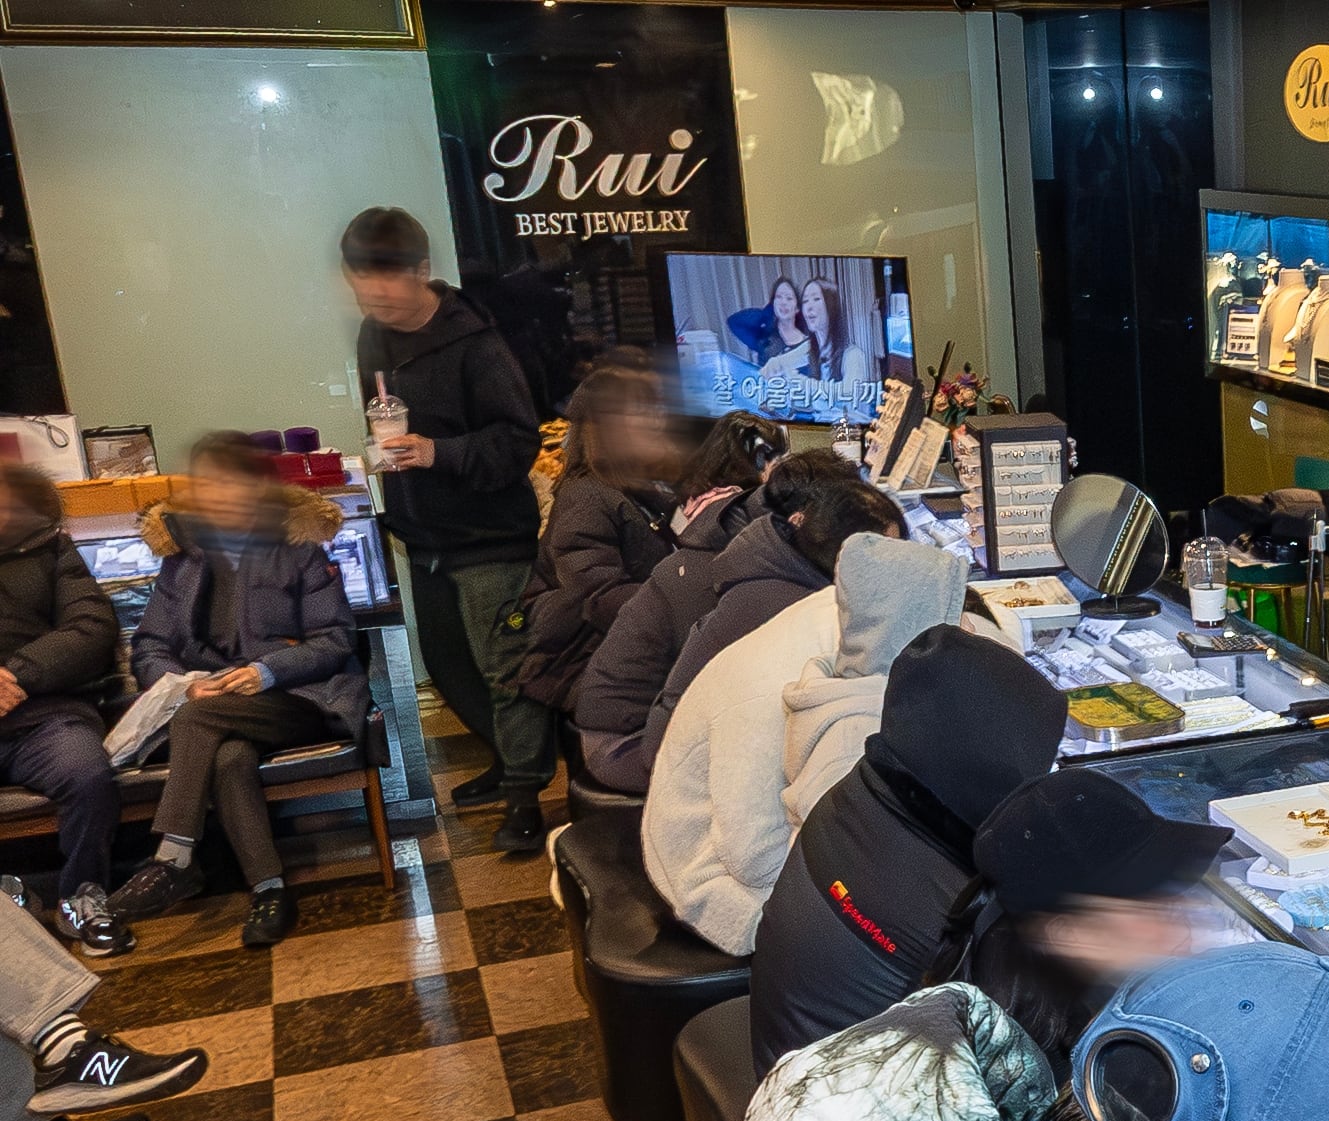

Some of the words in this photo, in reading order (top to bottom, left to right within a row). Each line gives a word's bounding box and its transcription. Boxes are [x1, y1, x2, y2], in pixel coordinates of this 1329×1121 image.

[483, 113, 707, 202] Rui
[516, 213, 577, 236] BEST
[581, 210, 690, 241] JEWELRY
[713, 374, 736, 406] 잘
[741, 376, 884, 411] 어울리시니까
